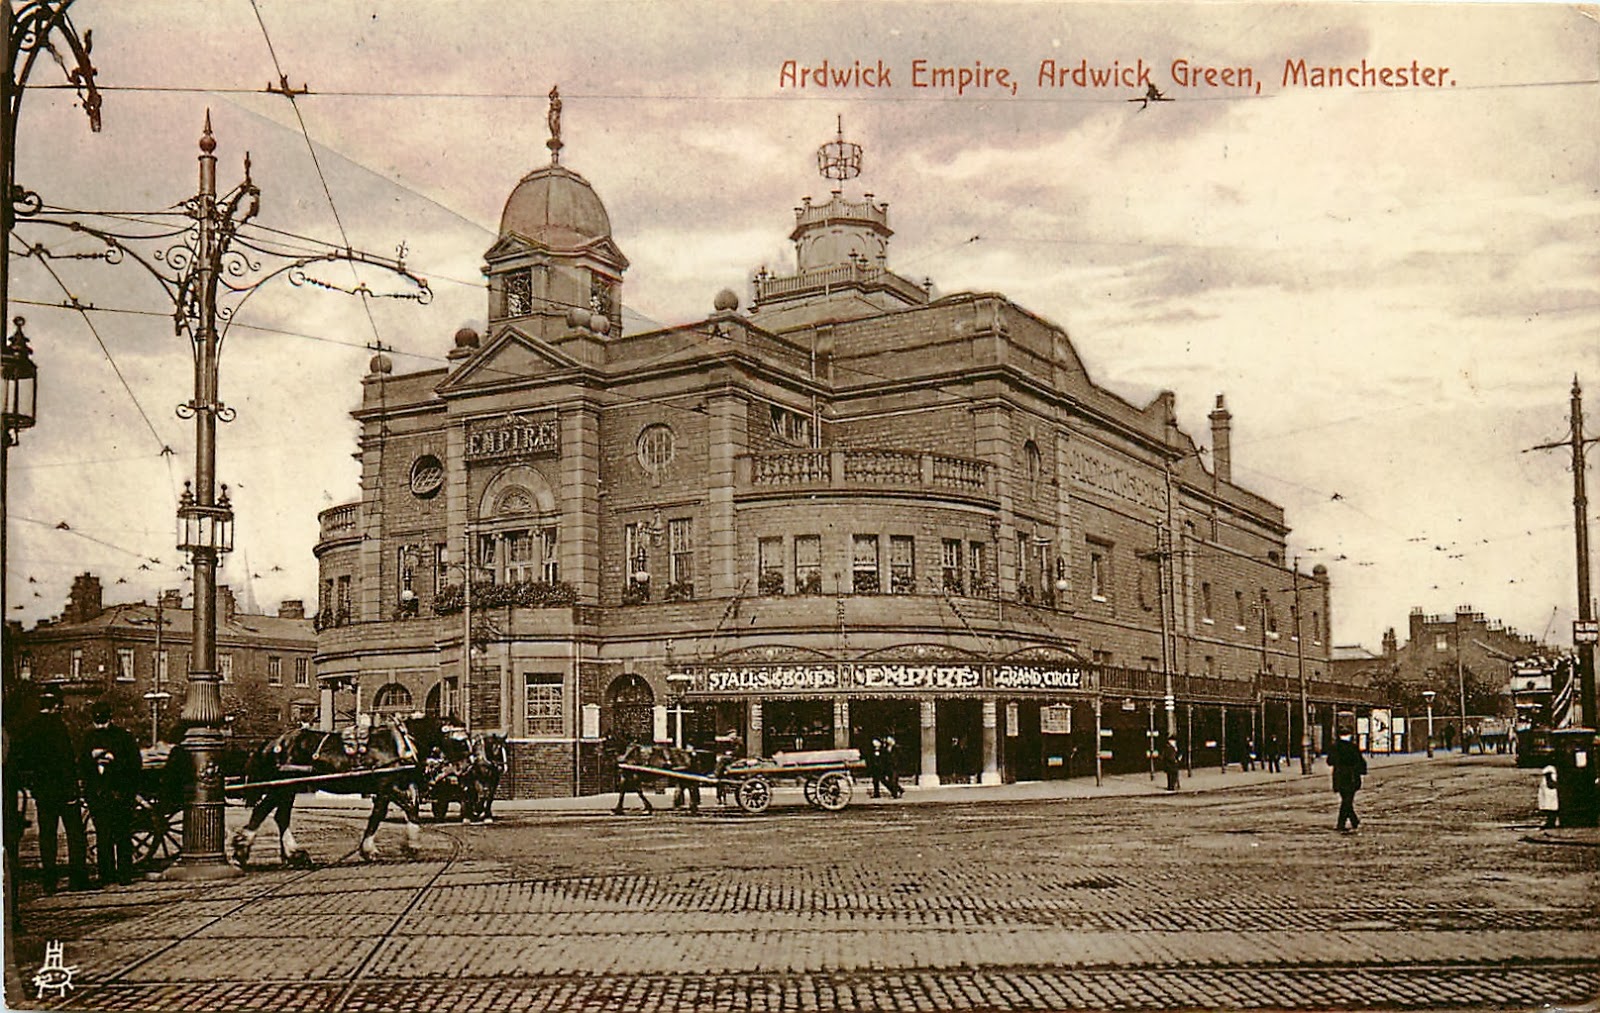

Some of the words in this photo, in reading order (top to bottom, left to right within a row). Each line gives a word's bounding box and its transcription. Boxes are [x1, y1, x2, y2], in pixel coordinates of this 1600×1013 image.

[467, 422, 554, 456] EMPIRE
[709, 669, 769, 688] STALLS
[865, 666, 974, 687] EMPIRE
[999, 667, 1042, 687] GRAND
[1043, 670, 1080, 687] CIRCLE
